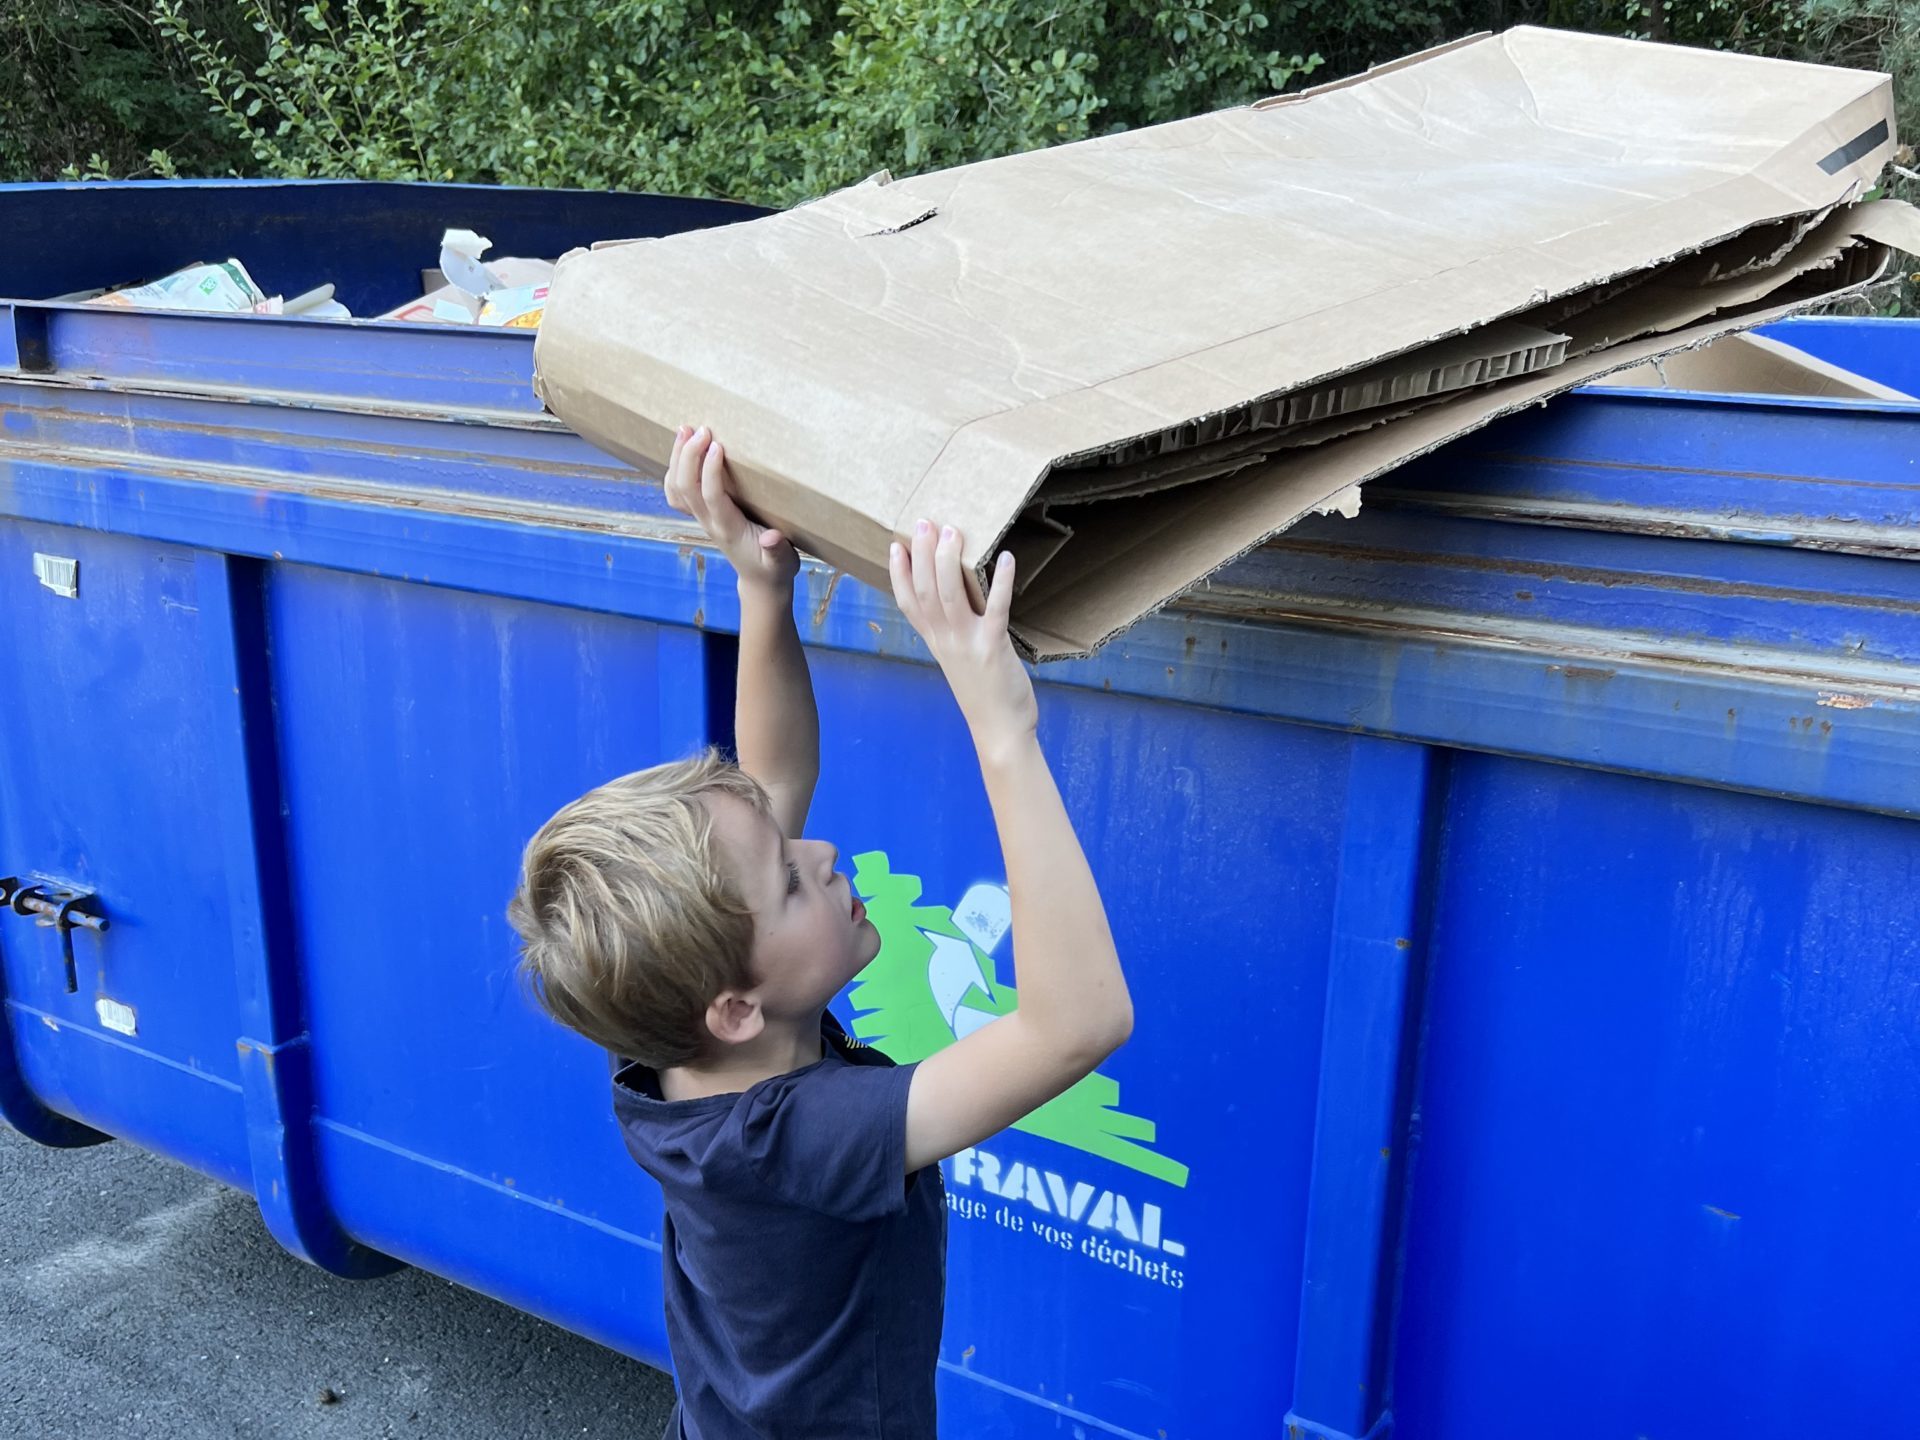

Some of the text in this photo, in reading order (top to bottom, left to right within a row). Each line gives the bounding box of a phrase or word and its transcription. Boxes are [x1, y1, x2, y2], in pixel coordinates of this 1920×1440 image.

[946, 1192, 1185, 1289] age de vos déchets
